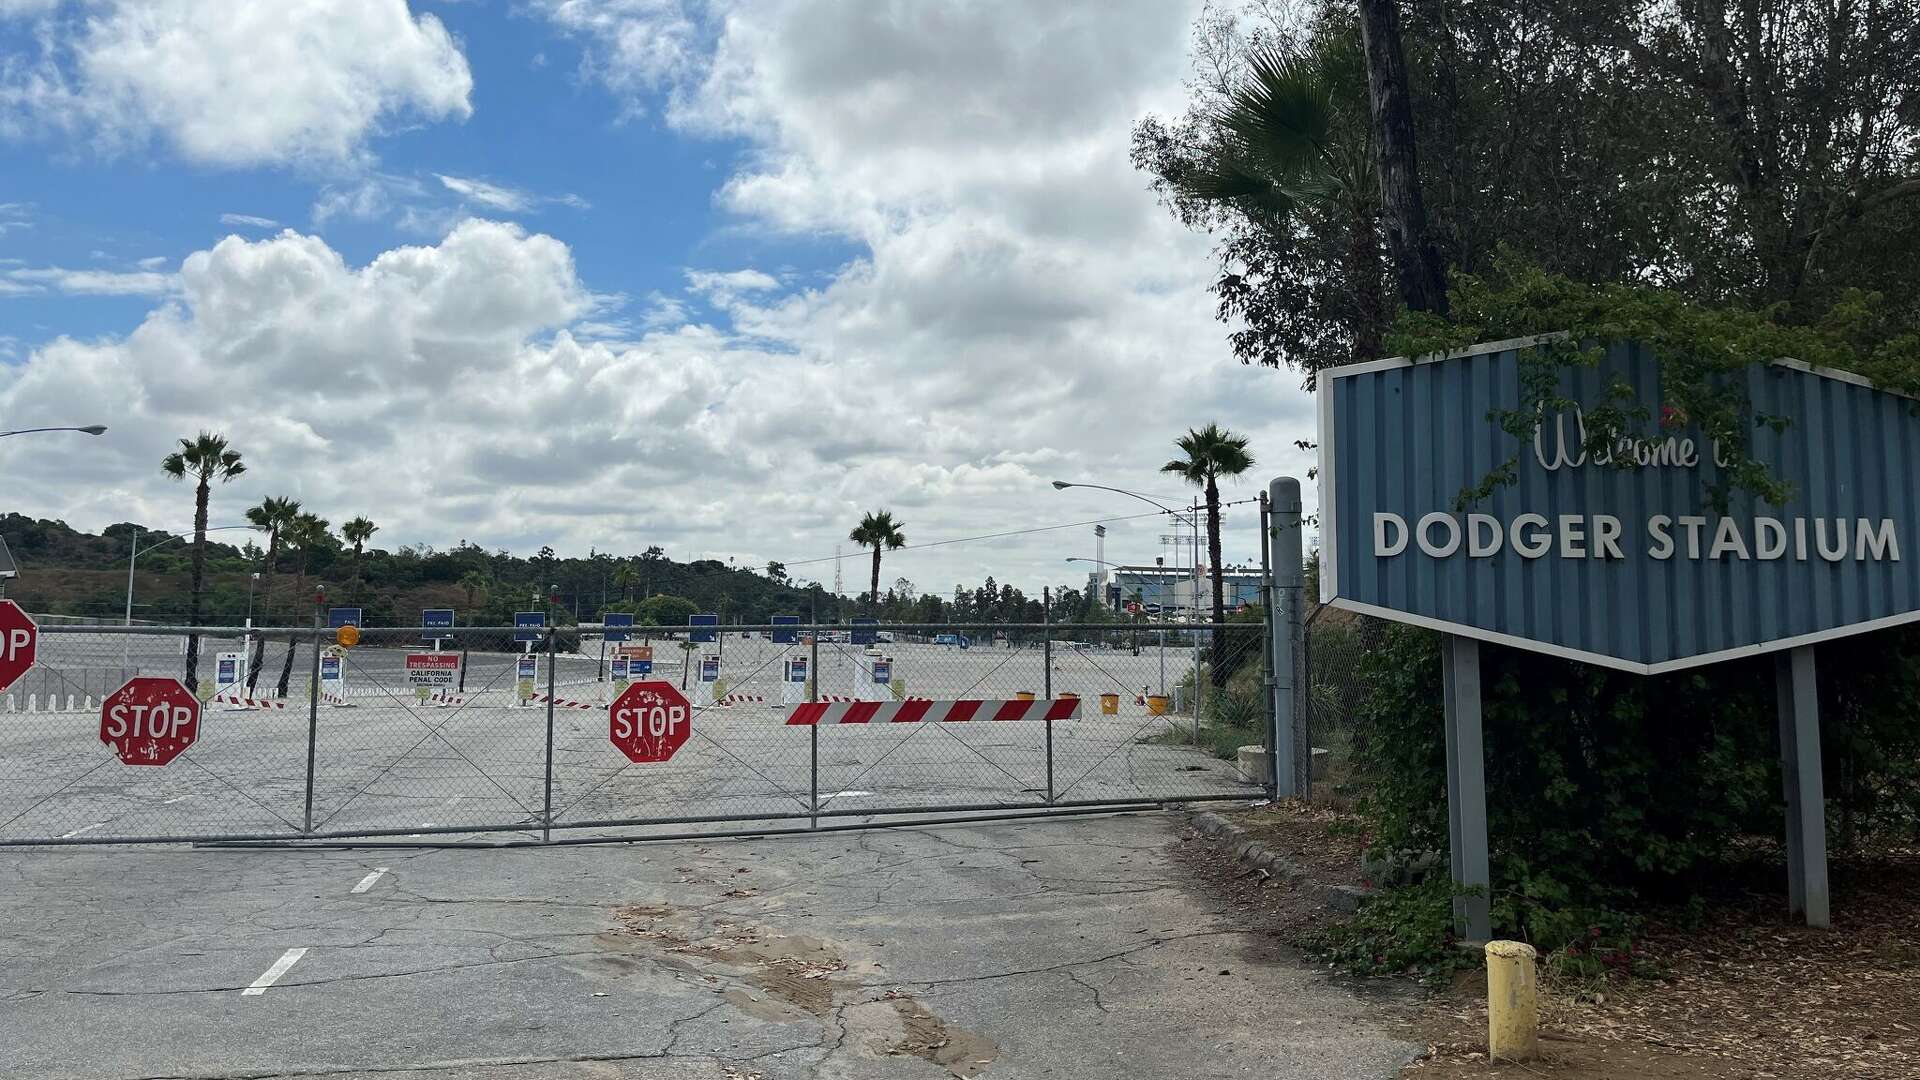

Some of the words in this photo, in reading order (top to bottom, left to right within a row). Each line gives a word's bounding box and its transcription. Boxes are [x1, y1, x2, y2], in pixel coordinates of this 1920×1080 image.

[1373, 511, 1625, 559] DODGER
[1647, 514, 1900, 561] STADIUM
[107, 703, 192, 738] STOP
[615, 706, 685, 738] STOP
